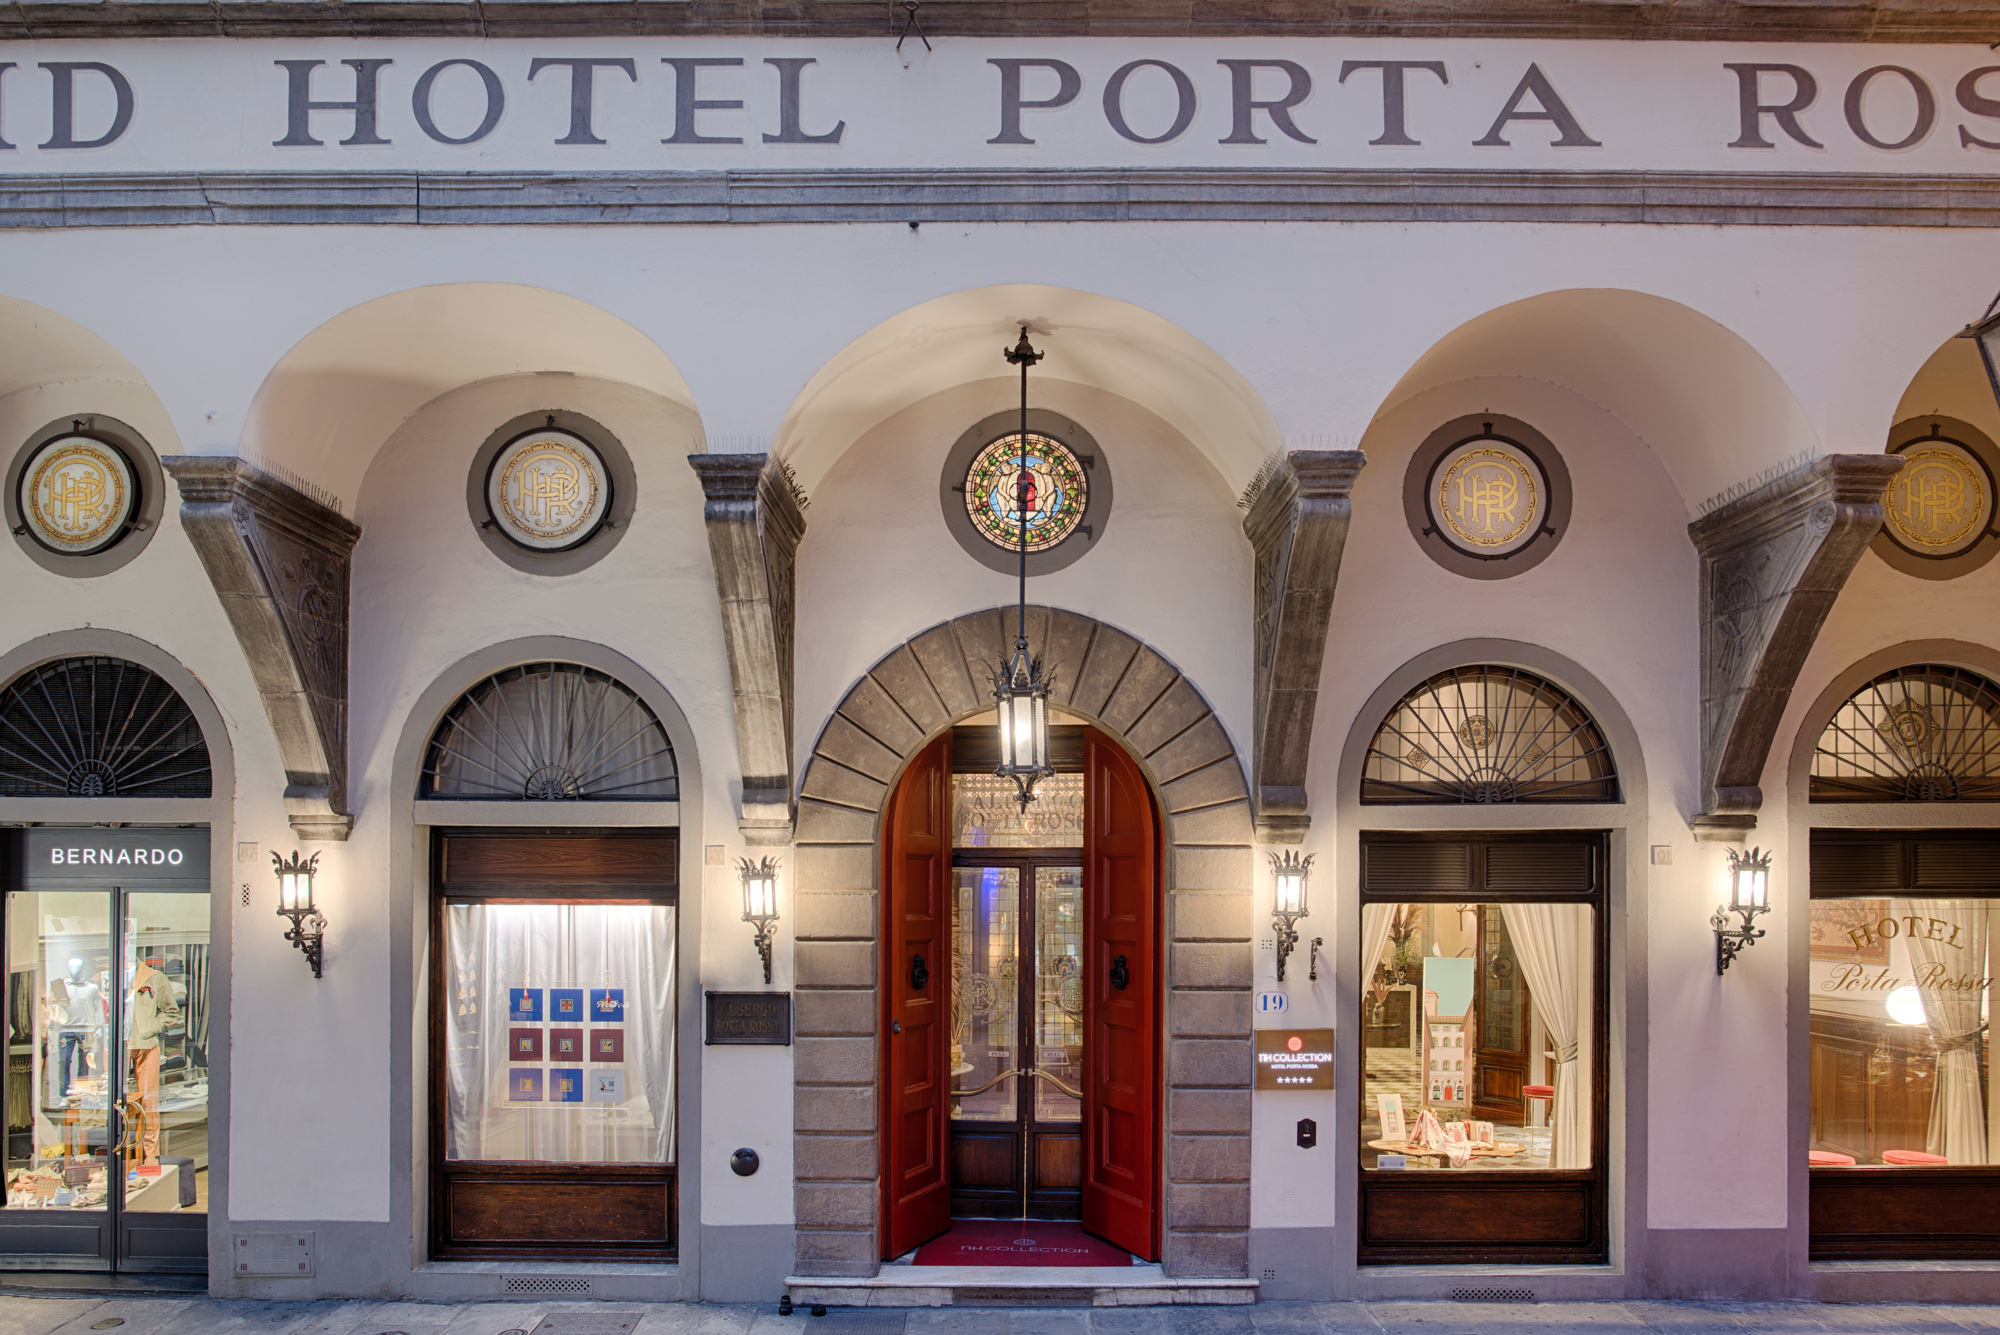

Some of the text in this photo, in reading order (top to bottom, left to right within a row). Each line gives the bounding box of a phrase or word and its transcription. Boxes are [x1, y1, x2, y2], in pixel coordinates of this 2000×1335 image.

[0, 61, 136, 150] D
[273, 58, 846, 147] HOTEL
[987, 58, 1604, 147] PORTA
[50, 848, 184, 866] BERNARDO
[240, 846, 258, 860] 87
[1656, 849, 1671, 864] 91
[1847, 916, 1966, 951] HOTEL
[1821, 961, 1996, 993] Porta Rossa
[718, 1002, 778, 1018] ALBERGO
[1262, 994, 1284, 1011] 19
[716, 1020, 781, 1034] PORTA ROSSA
[1272, 1053, 1333, 1063] COLLECTION
[985, 1246, 1090, 1254] COLLECTION
